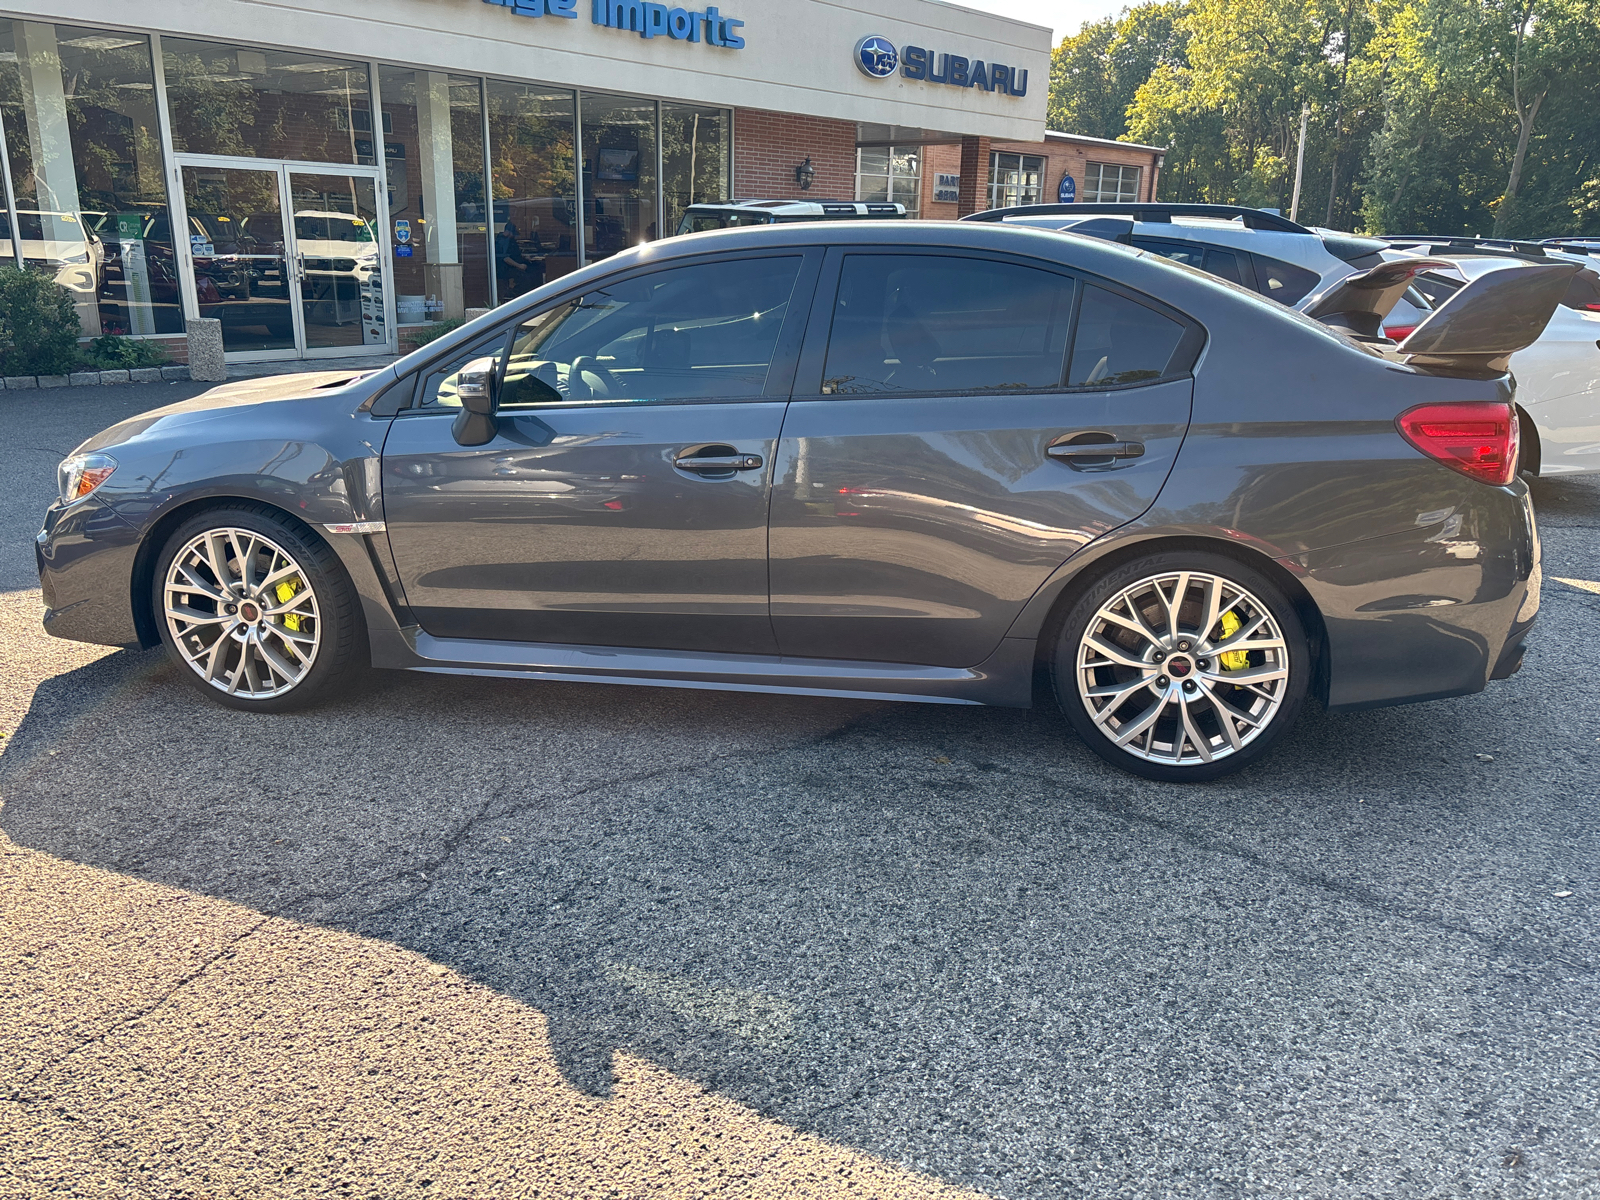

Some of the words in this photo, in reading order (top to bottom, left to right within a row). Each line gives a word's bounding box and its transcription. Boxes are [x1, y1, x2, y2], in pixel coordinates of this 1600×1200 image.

[900, 45, 1028, 97] SUBARU
[939, 174, 960, 187] PART
[1064, 556, 1168, 642] CONTINENTAL
